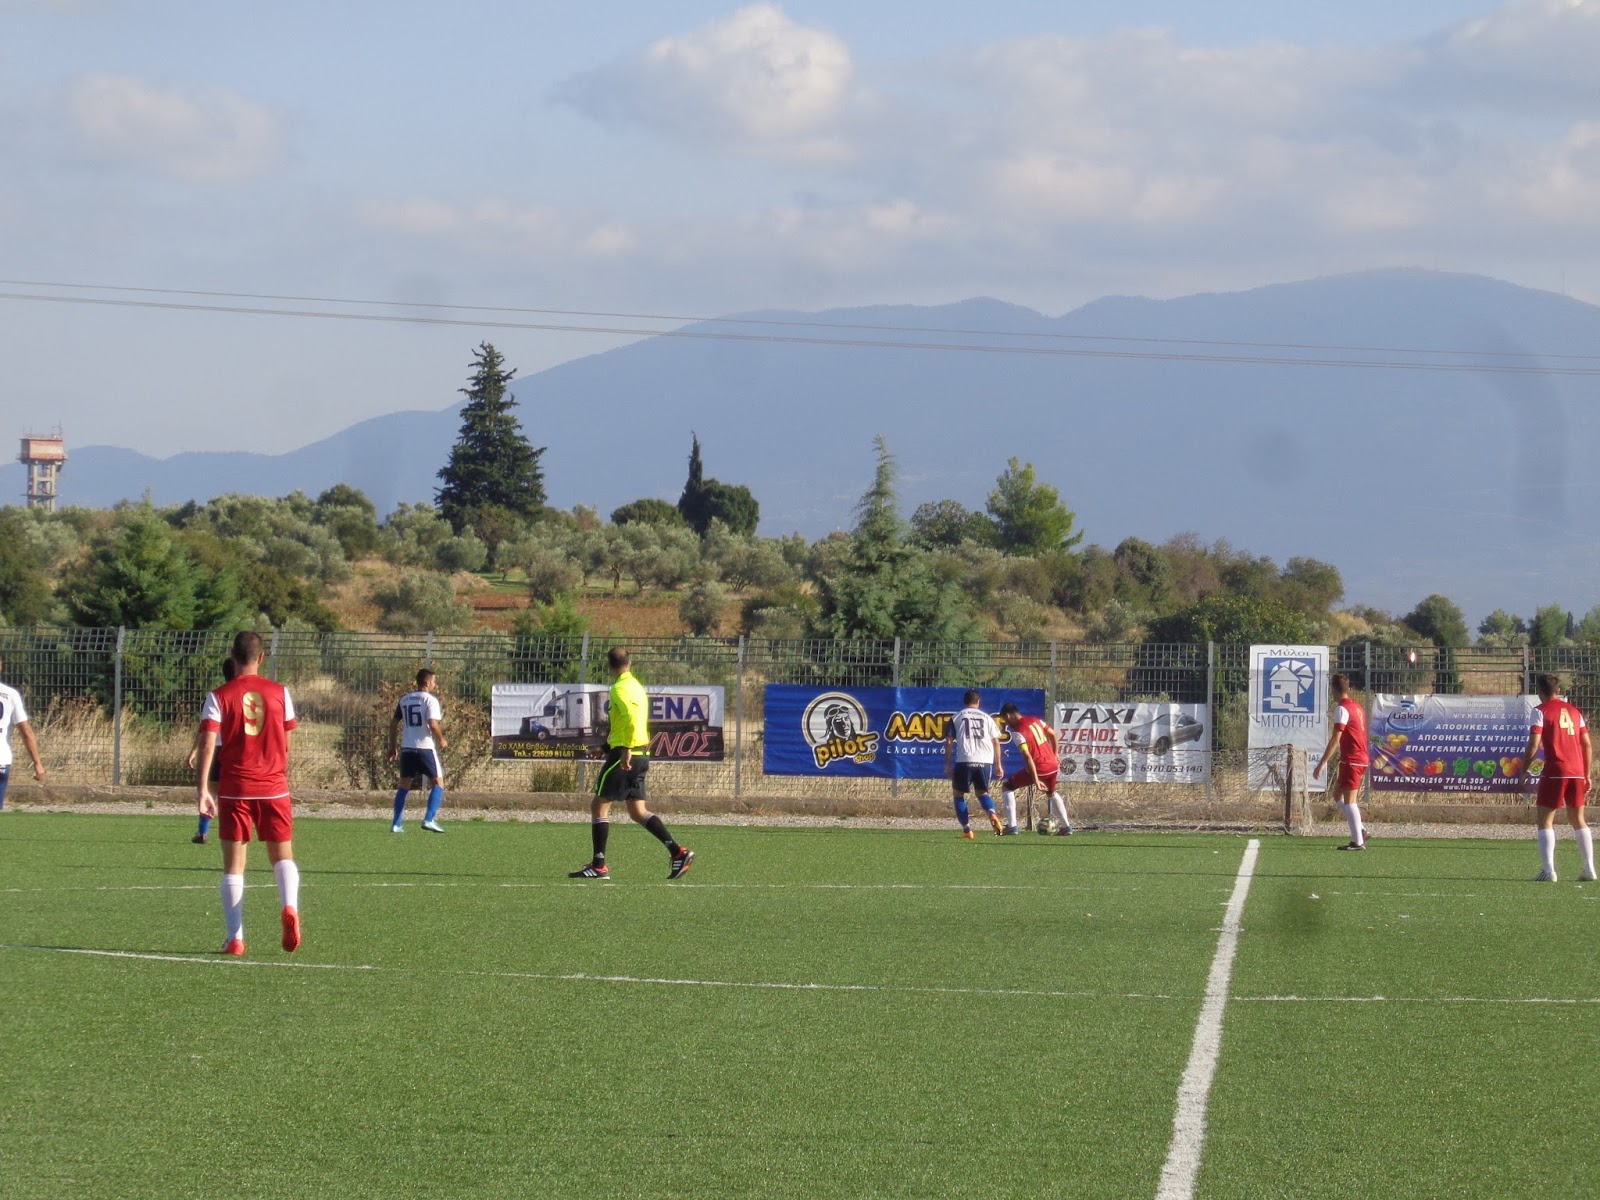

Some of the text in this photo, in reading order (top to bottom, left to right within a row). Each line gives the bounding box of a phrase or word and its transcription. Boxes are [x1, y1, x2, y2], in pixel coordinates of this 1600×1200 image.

[242, 691, 264, 736] 9
[403, 704, 422, 727] 16
[1061, 708, 1136, 724] TAXI
[1393, 712, 1424, 720] Liakos
[1261, 714, 1314, 728] ΜΠΟΓΡΗ
[1435, 723, 1488, 731] ΑΠΟΘΗΚΕΣ
[1559, 707, 1575, 736] 4
[962, 717, 985, 740] 13
[1059, 728, 1118, 742] ΣΤΕΝΟΣ
[1417, 734, 1471, 742] ΑΠΟΘΗΚΕΣ
[816, 734, 876, 765] pilot
[1405, 745, 1486, 753] ΕΠΑΓΓΕΛΜΑΤΙΚΑ
[854, 754, 875, 763] shop
